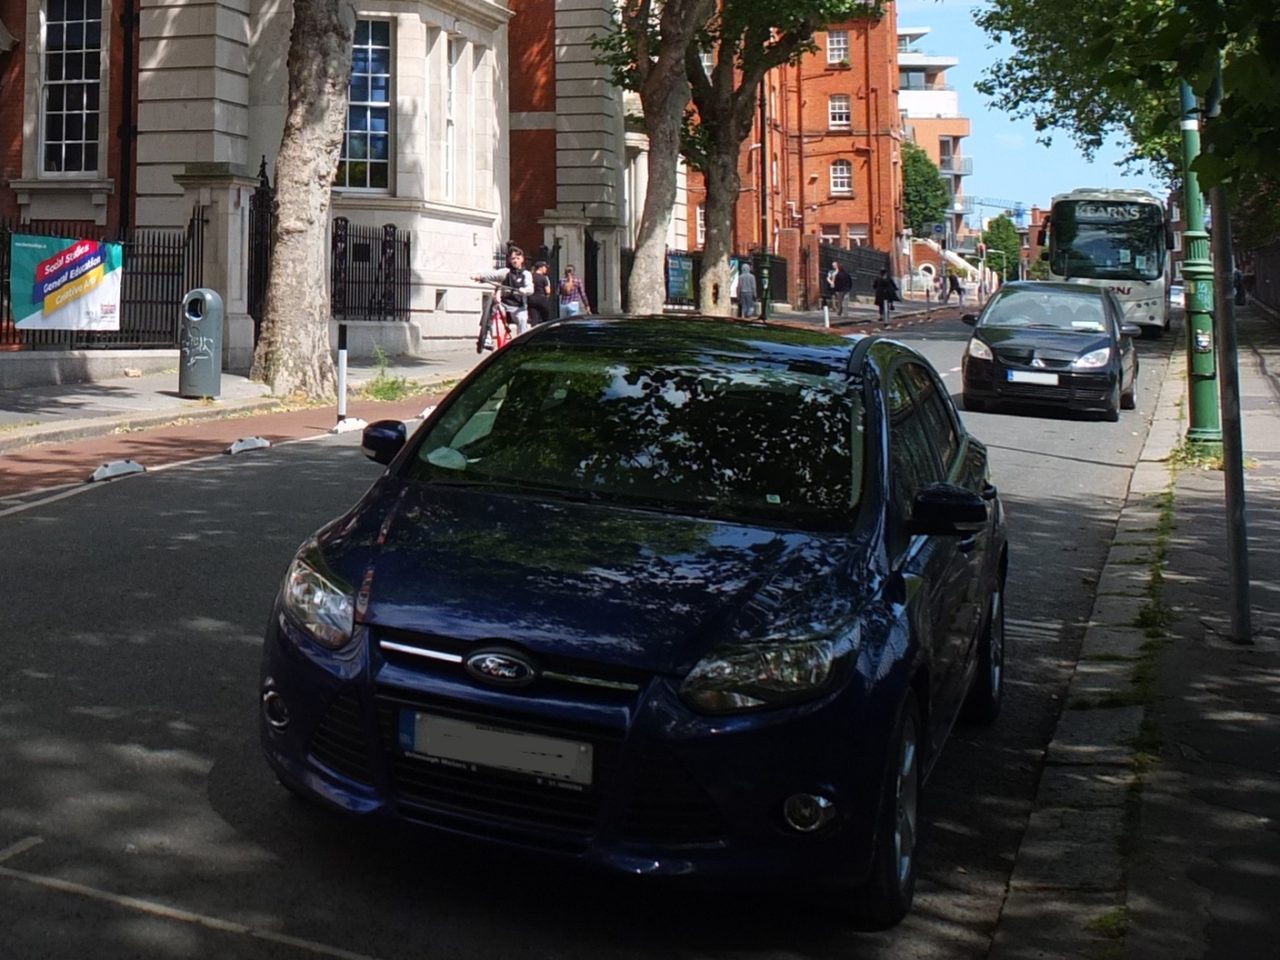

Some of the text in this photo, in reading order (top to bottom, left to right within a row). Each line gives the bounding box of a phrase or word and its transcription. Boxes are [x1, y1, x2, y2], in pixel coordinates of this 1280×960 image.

[1075, 205, 1140, 219] KEARNS
[44, 243, 90, 275] Social Studies
[43, 255, 101, 293] General Education
[481, 656, 518, 677] Ford
